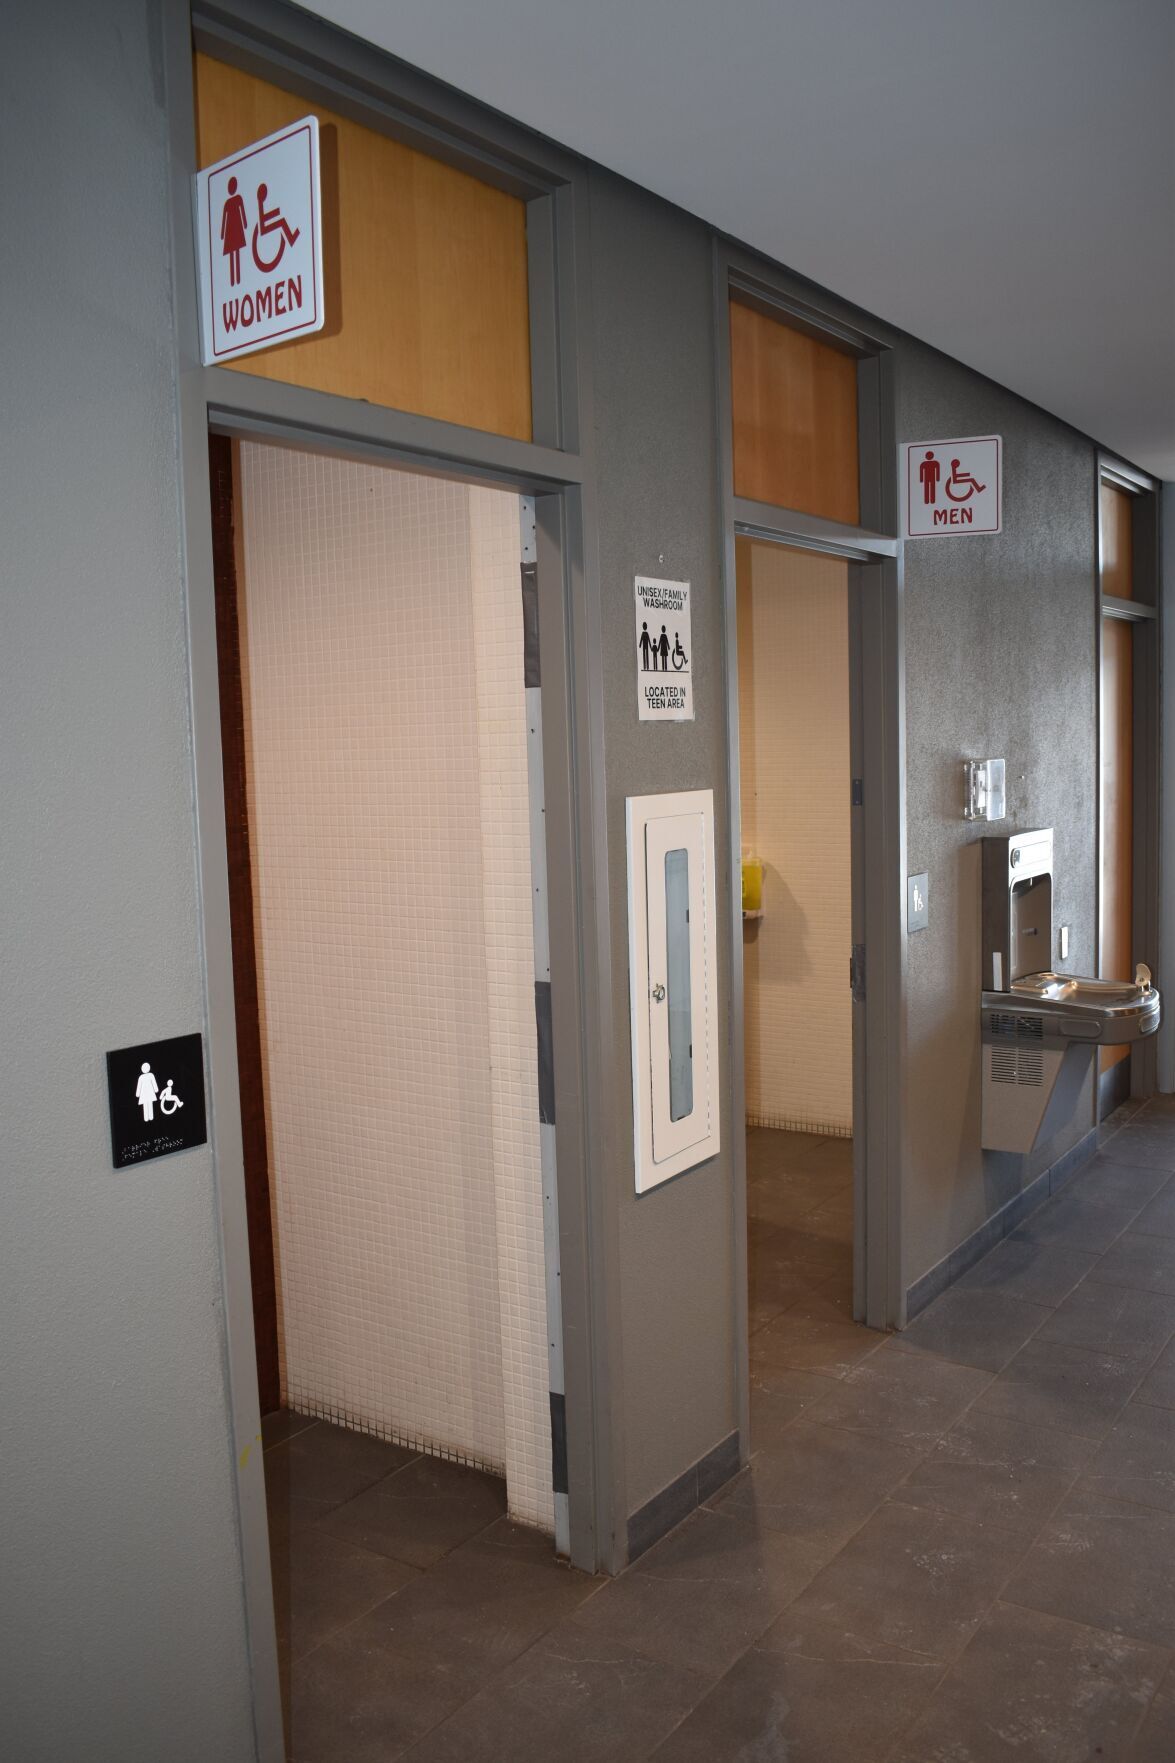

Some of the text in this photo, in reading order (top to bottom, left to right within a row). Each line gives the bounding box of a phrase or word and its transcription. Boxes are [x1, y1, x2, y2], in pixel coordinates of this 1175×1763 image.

[223, 275, 302, 334] WOMEN
[934, 507, 973, 525] MEN
[638, 586, 688, 601] UNISEX/FAMILY
[643, 597, 683, 611] WASHROOM
[645, 686, 686, 698] LOCATED IN
[647, 698, 685, 709] TEEN AREA
